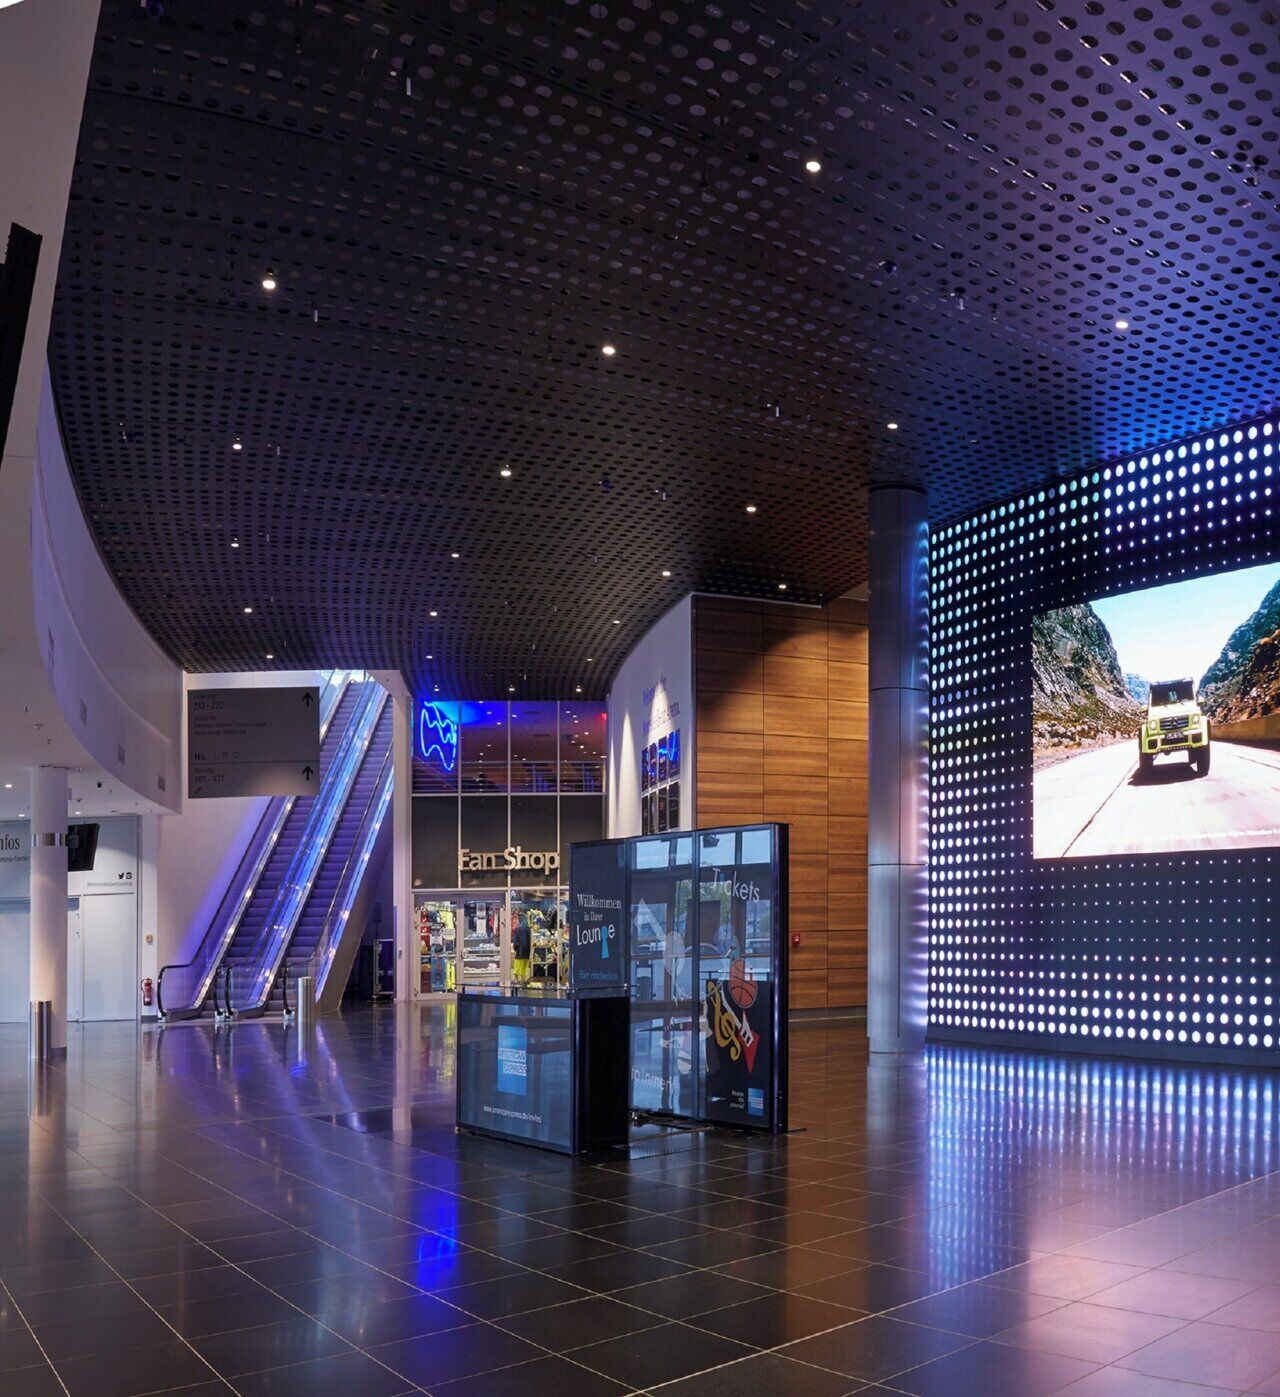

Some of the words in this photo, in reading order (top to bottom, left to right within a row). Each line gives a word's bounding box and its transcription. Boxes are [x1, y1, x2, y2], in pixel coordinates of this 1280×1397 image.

[459, 848, 496, 871] Fan
[504, 846, 560, 875] Shop
[576, 893, 622, 909] Willkommen
